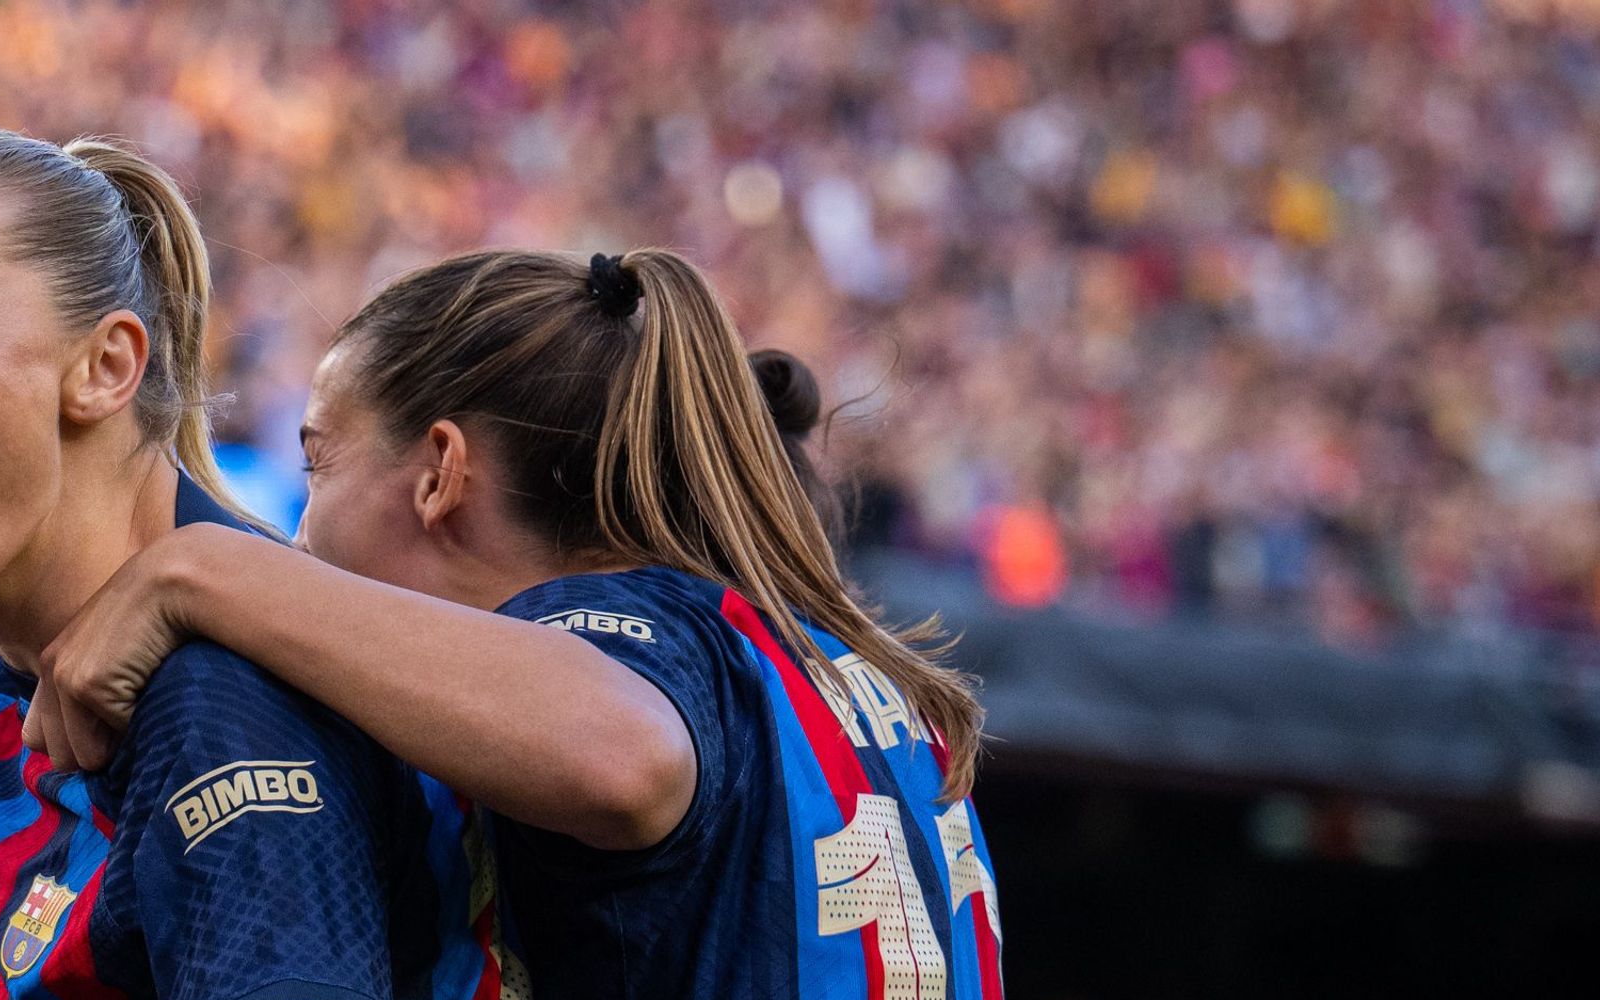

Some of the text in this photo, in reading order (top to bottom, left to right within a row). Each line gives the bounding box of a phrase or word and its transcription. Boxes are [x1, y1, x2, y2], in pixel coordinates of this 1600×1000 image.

[546, 612, 652, 640] MBO
[173, 769, 319, 839] BIMBO
[22, 918, 42, 935] FCB
